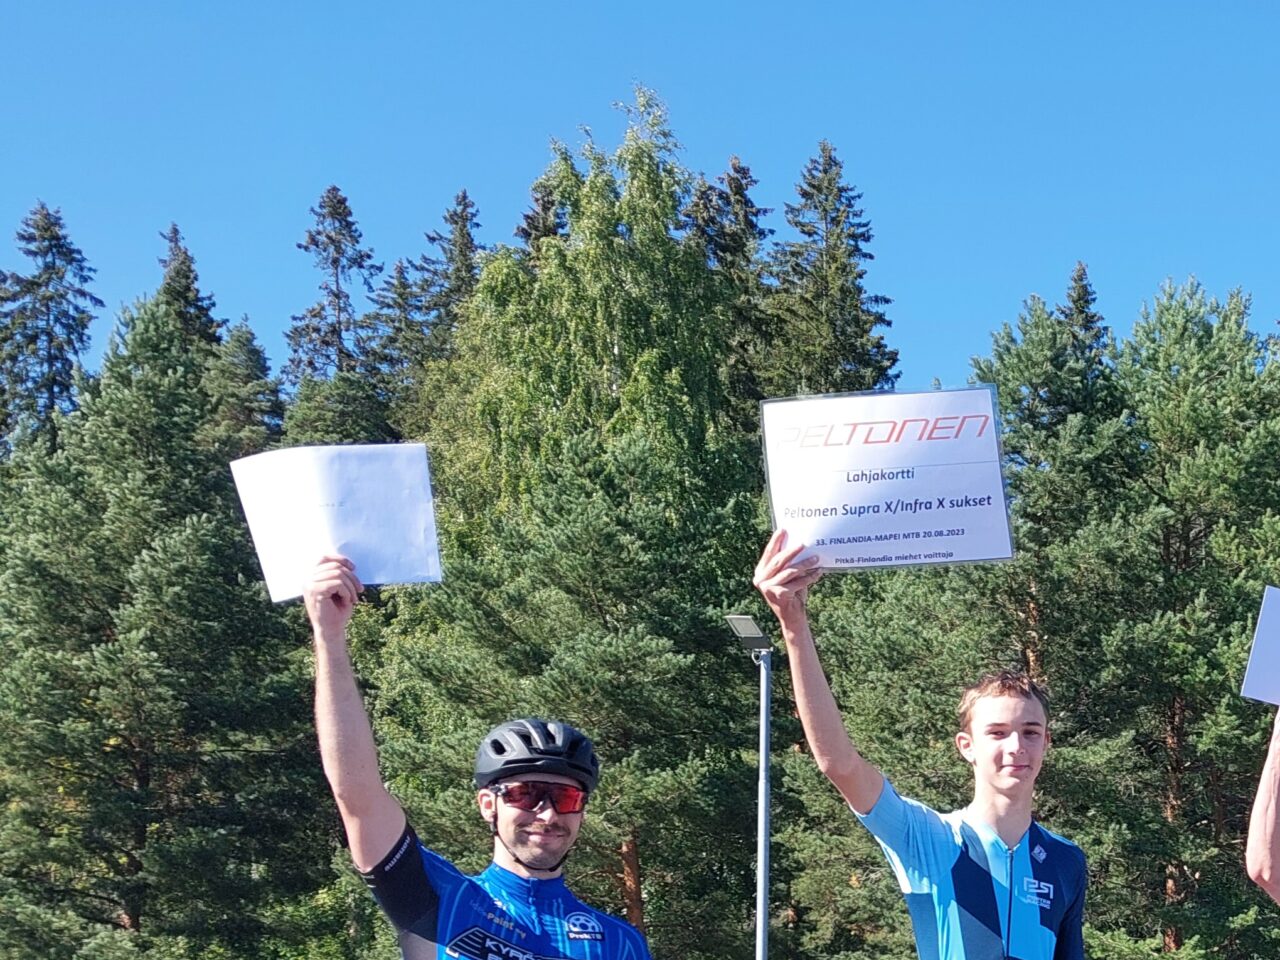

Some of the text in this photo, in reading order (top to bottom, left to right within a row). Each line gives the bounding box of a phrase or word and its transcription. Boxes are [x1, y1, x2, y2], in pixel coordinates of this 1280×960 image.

[846, 467, 916, 484] Lahjakortti
[784, 495, 993, 519] Peltonen Supra X/Infra X sukset
[829, 532, 901, 545] FINLANDIA-MAPEI
[902, 531, 921, 540] MTB
[922, 528, 965, 539] 20.08.2023
